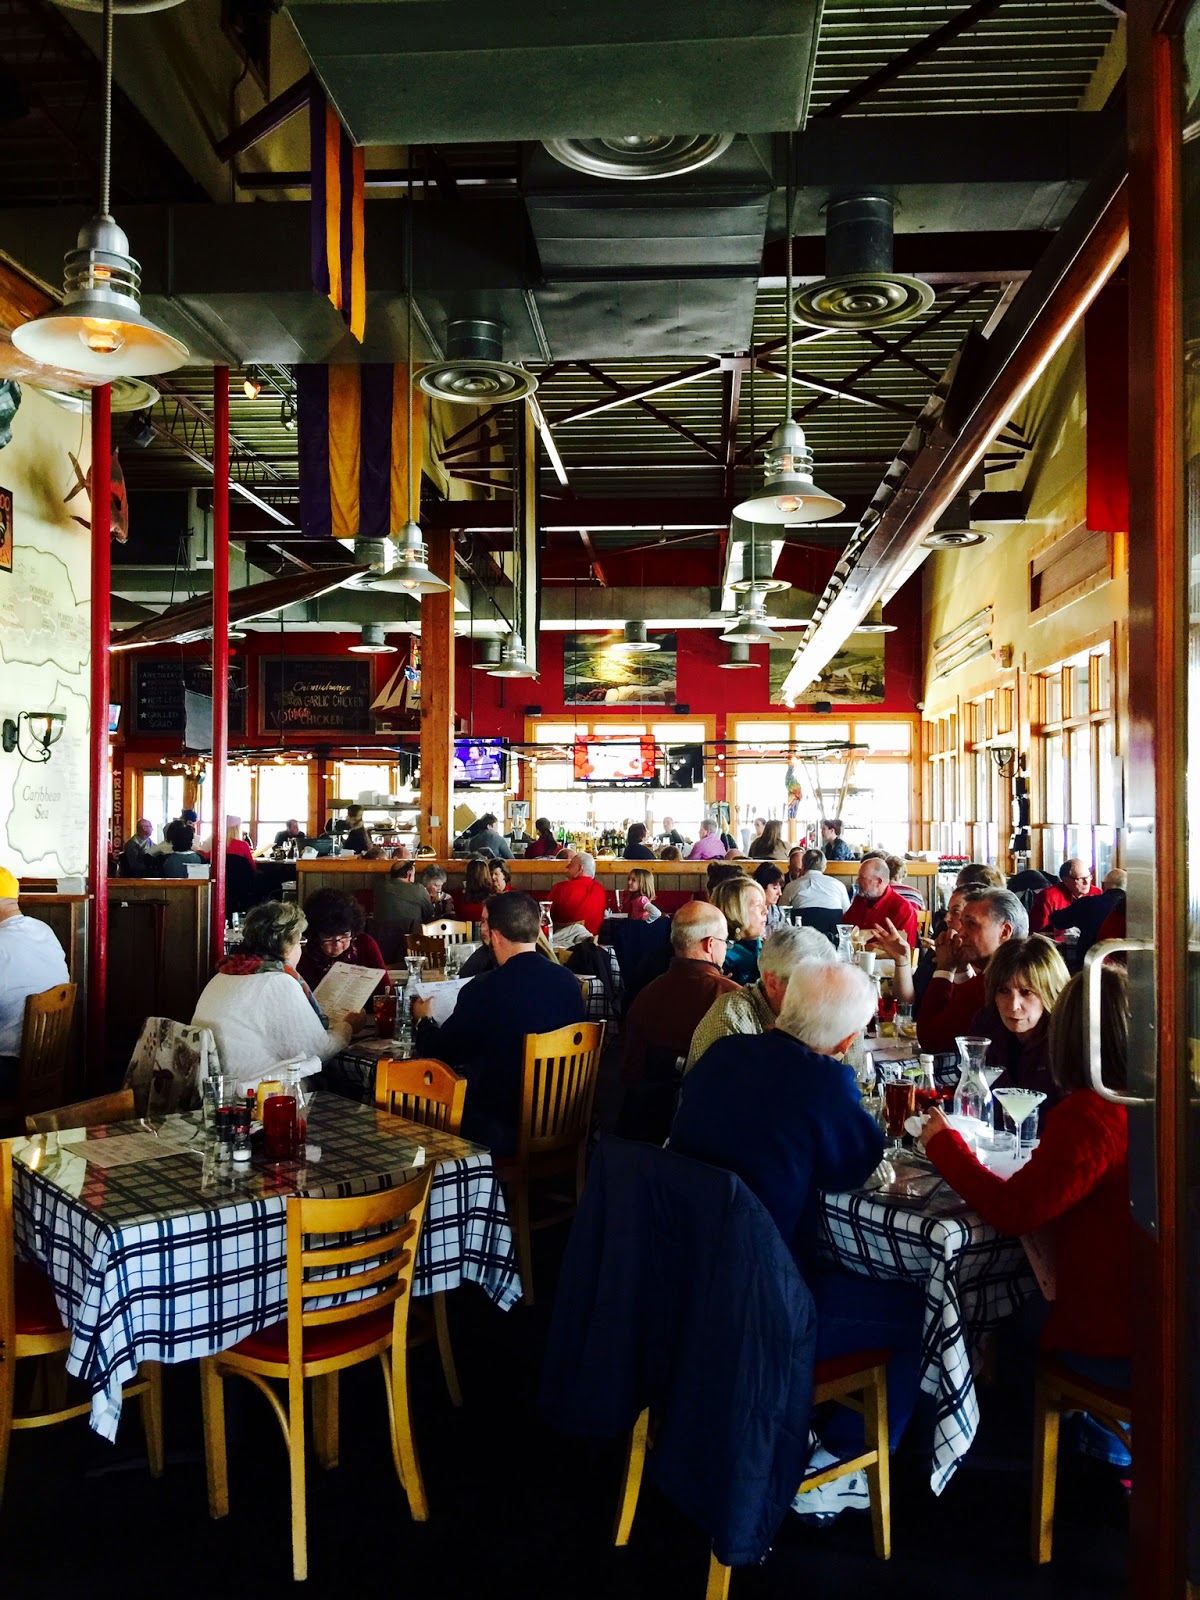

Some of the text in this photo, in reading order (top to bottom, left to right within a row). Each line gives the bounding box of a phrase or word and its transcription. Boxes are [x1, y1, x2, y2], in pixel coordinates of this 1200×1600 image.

[304, 694, 331, 708] GARLIC
[332, 694, 364, 708] CHICKEN
[301, 714, 344, 726] CHICKEN
[23, 785, 61, 802] Caribbean
[35, 804, 49, 820] Sea
